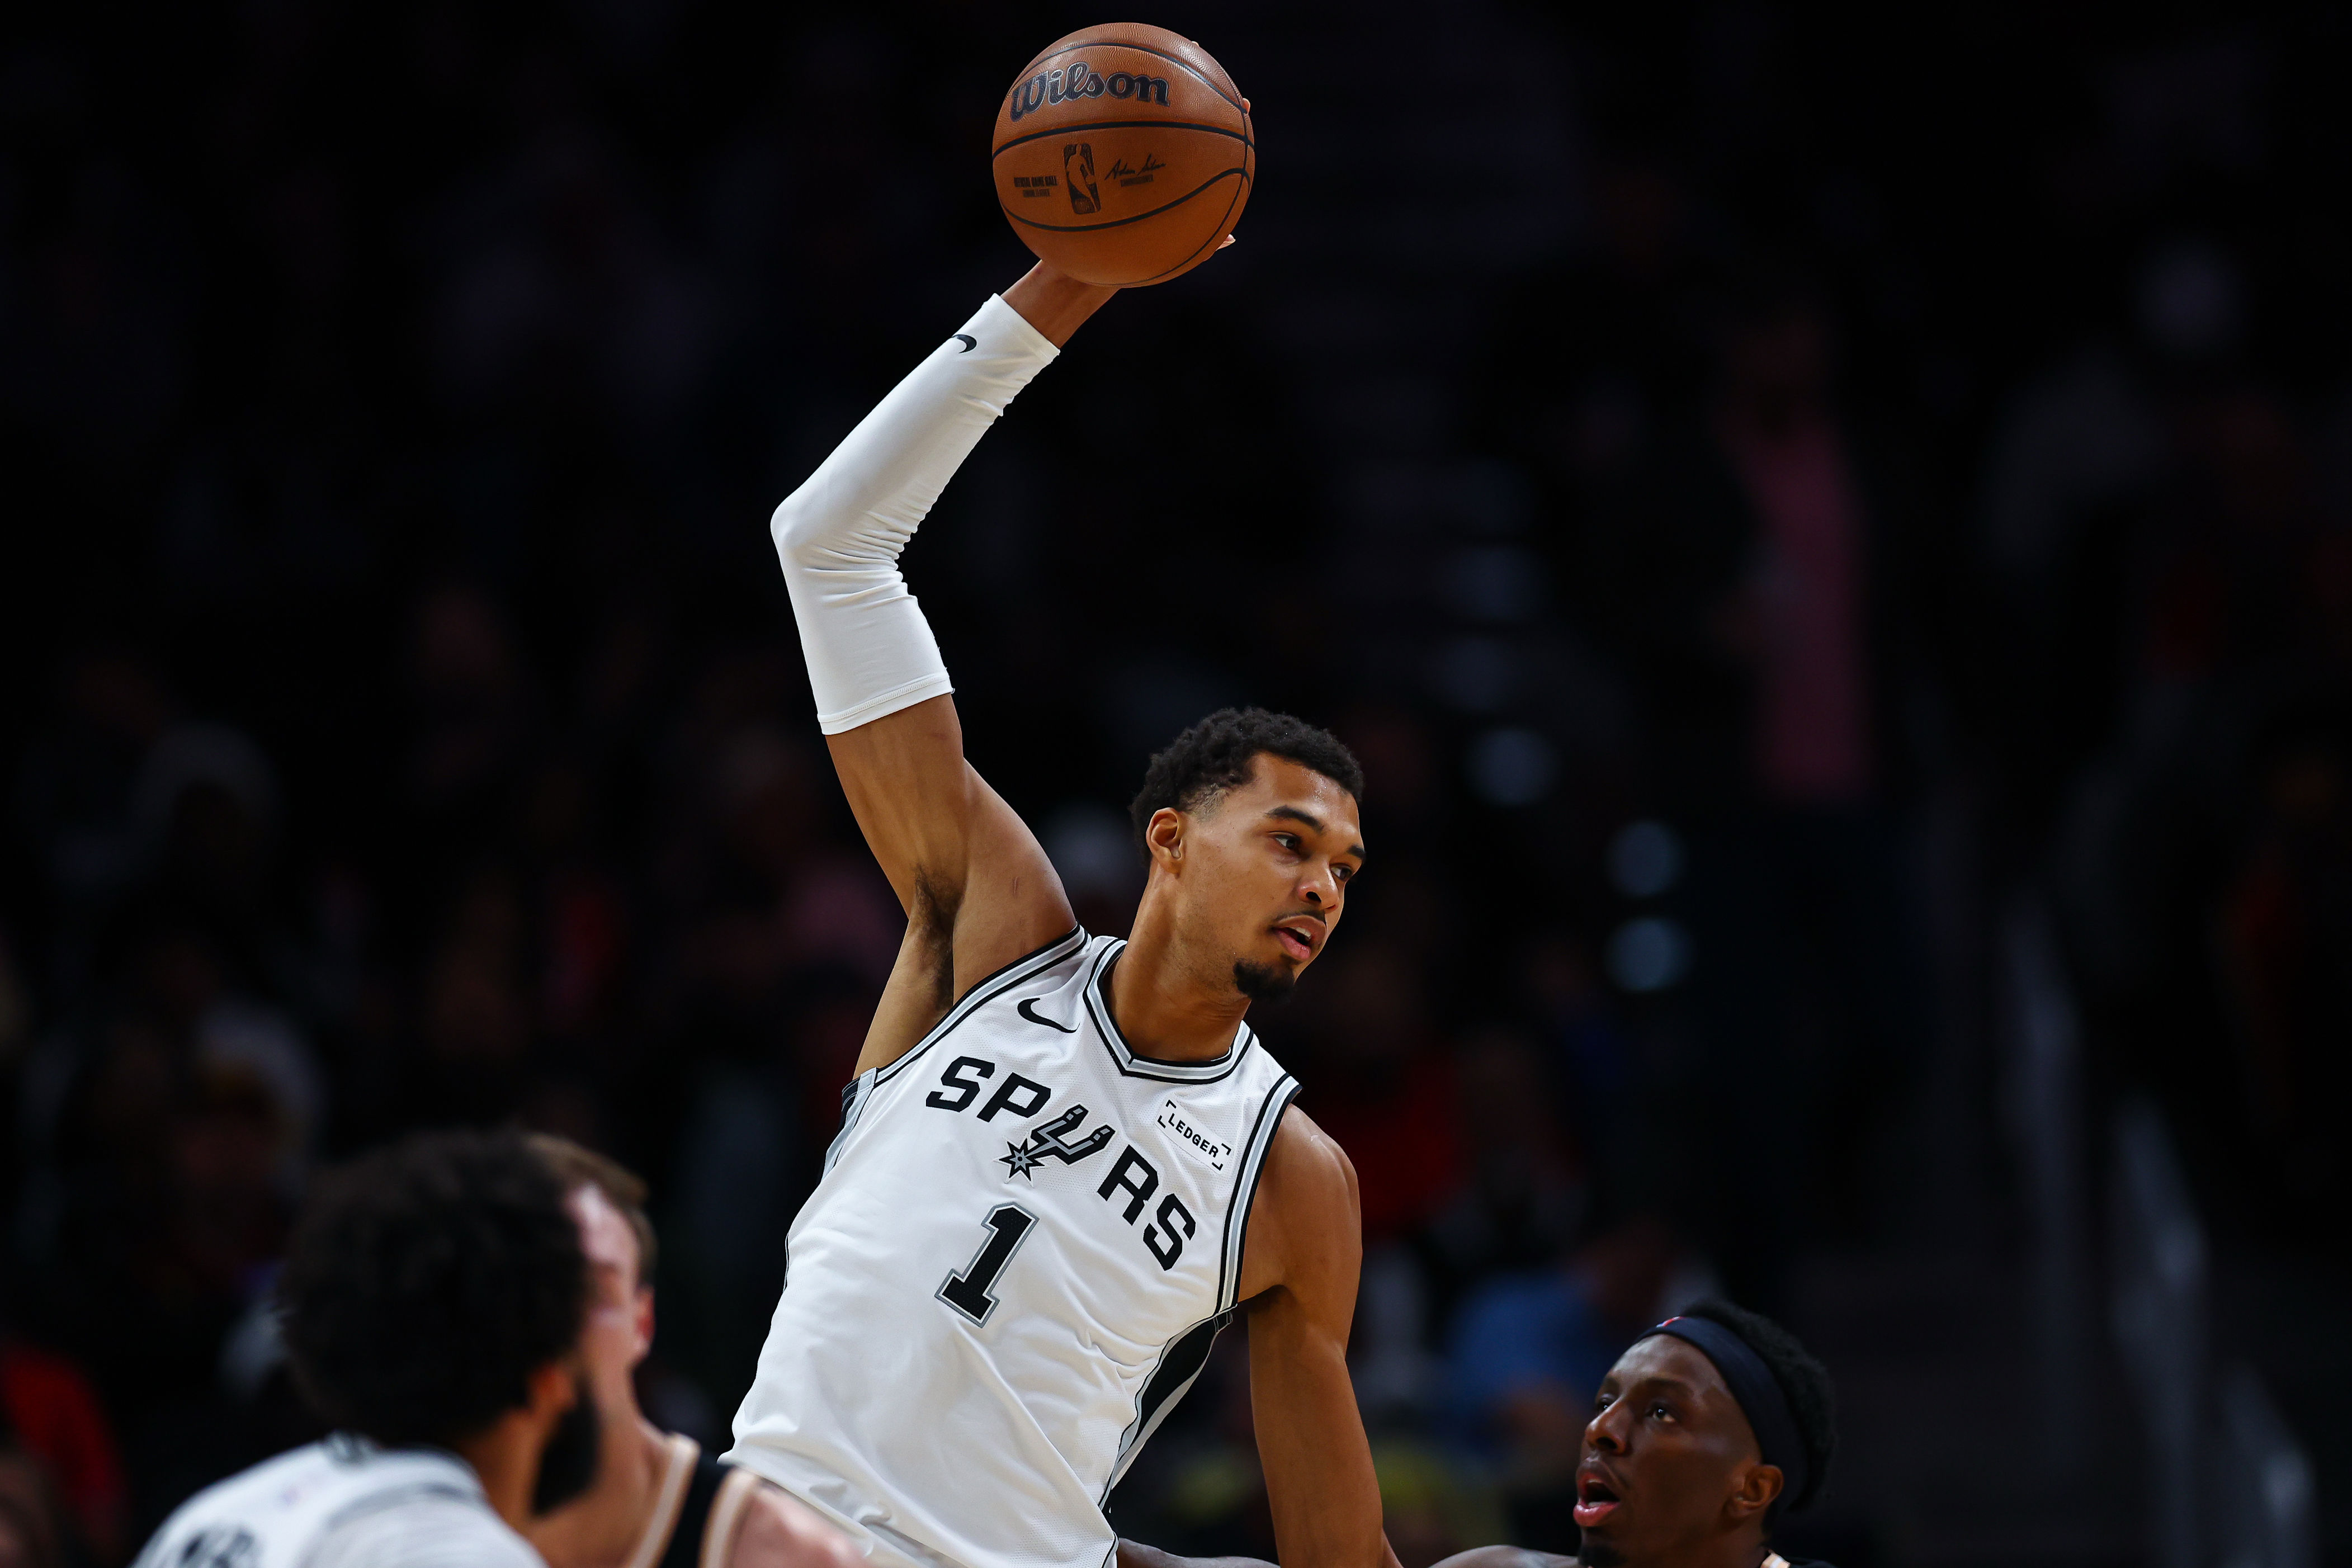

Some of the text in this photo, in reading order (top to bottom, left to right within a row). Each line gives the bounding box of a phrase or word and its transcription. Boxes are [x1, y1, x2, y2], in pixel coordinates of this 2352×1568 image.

[1010, 62, 1170, 121] Wilson
[925, 1056, 1196, 1271] SPURS
[1168, 1113, 1218, 1158] LEDGER
[934, 1202, 1040, 1328] 1
